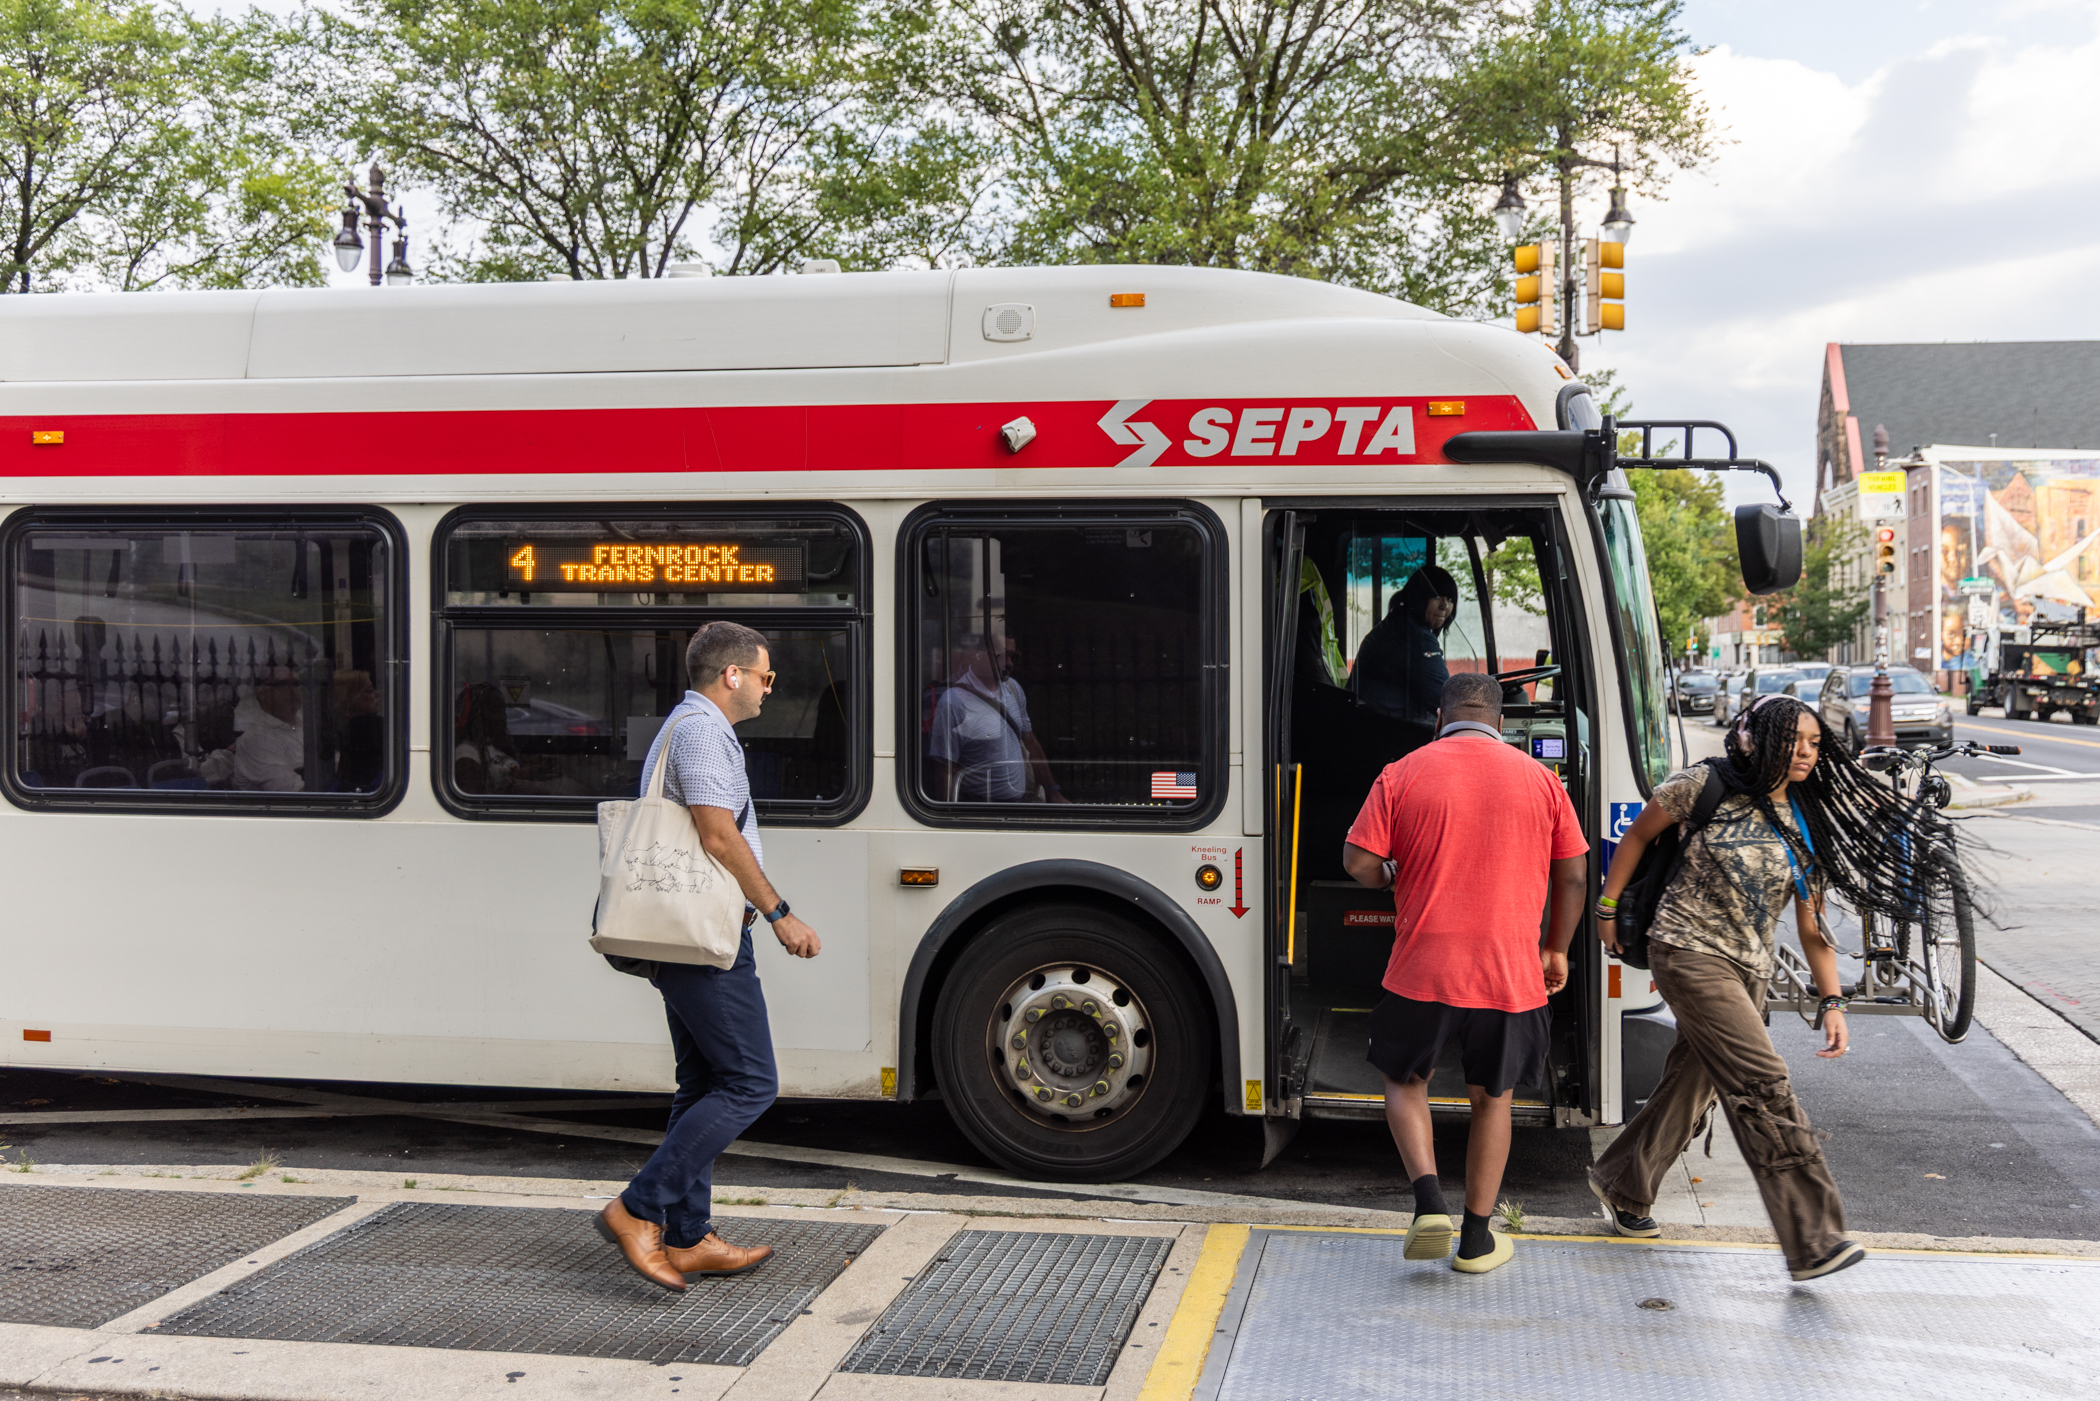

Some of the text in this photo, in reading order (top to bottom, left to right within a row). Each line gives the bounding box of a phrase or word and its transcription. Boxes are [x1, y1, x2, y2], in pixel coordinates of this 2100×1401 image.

[1183, 406, 1416, 458] SEPTA
[511, 546, 535, 581] 4
[594, 546, 739, 565] FERNROCK
[560, 564, 774, 581] TRANS CENTER
[1191, 846, 1227, 854] Kneeling
[1197, 897, 1222, 905] RAMP
[1349, 915, 1379, 923] PLEASE
